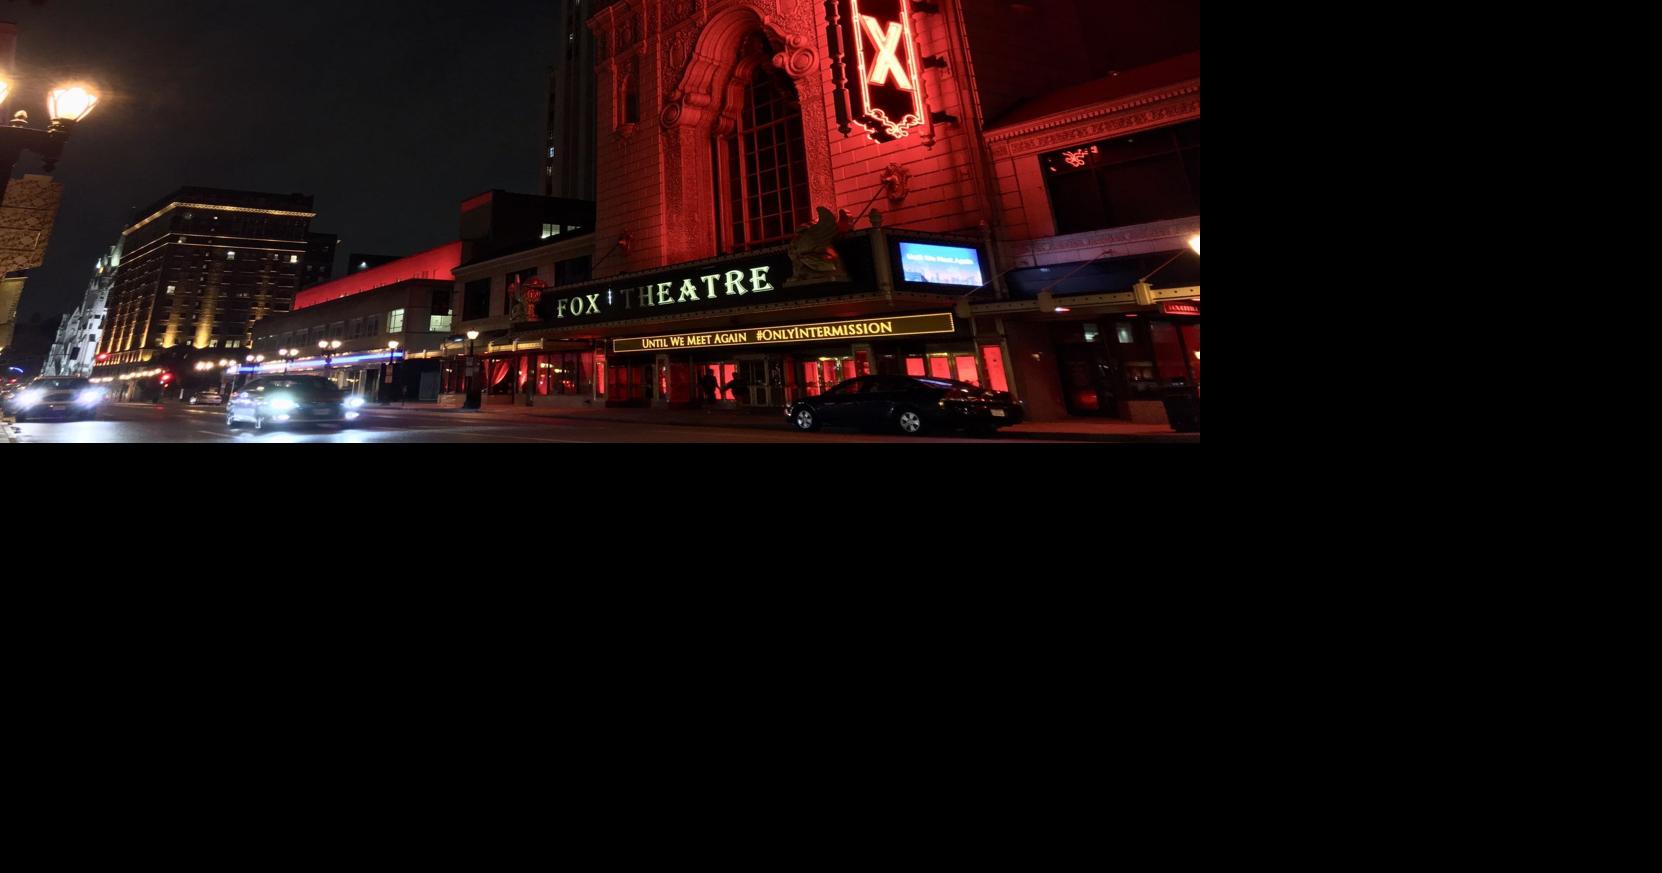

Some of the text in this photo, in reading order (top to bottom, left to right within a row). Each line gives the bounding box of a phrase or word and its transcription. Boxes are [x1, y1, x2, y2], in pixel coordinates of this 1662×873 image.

[557, 265, 775, 318] FOX THEATRE
[642, 321, 893, 349] UNTIL WE MEET AGAIN #ONLYINTERMISSION
